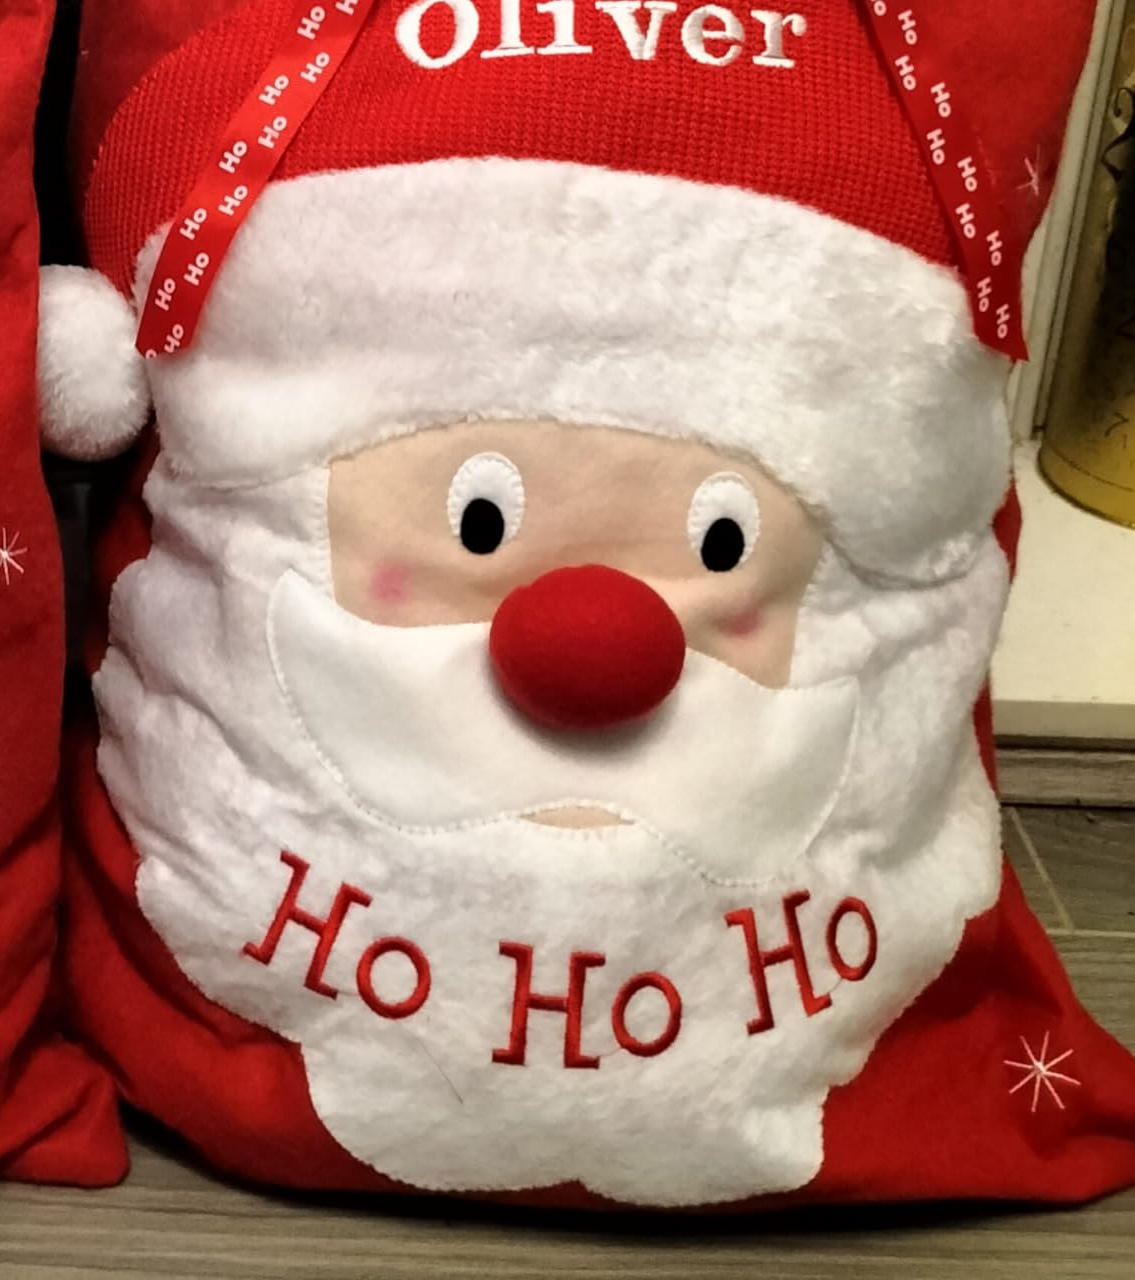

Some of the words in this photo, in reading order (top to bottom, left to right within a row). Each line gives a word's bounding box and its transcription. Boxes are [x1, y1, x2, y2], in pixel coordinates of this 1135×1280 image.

[155, 279, 175, 310] Ho
[180, 208, 206, 239] Ho
[219, 142, 247, 173] Ho
[259, 76, 288, 104] Ho
[298, 7, 325, 39] Ho
[184, 253, 209, 285] Ho
[219, 186, 247, 215] Ho
[258, 117, 287, 148] Ho
[301, 53, 329, 82] Ho
[895, 56, 915, 90] Ho
[927, 129, 945, 164] Ho
[956, 204, 975, 238] Ho
[977, 277, 991, 312] Ho
[898, 10, 916, 44] Ho
[931, 83, 950, 117] Ho
[958, 157, 977, 191] Ho
[987, 231, 1002, 265] Ho
[996, 304, 1010, 338] Ho
[241, 848, 432, 1020] Ho
[491, 940, 683, 1070] Ho
[724, 888, 879, 1037] Ho
